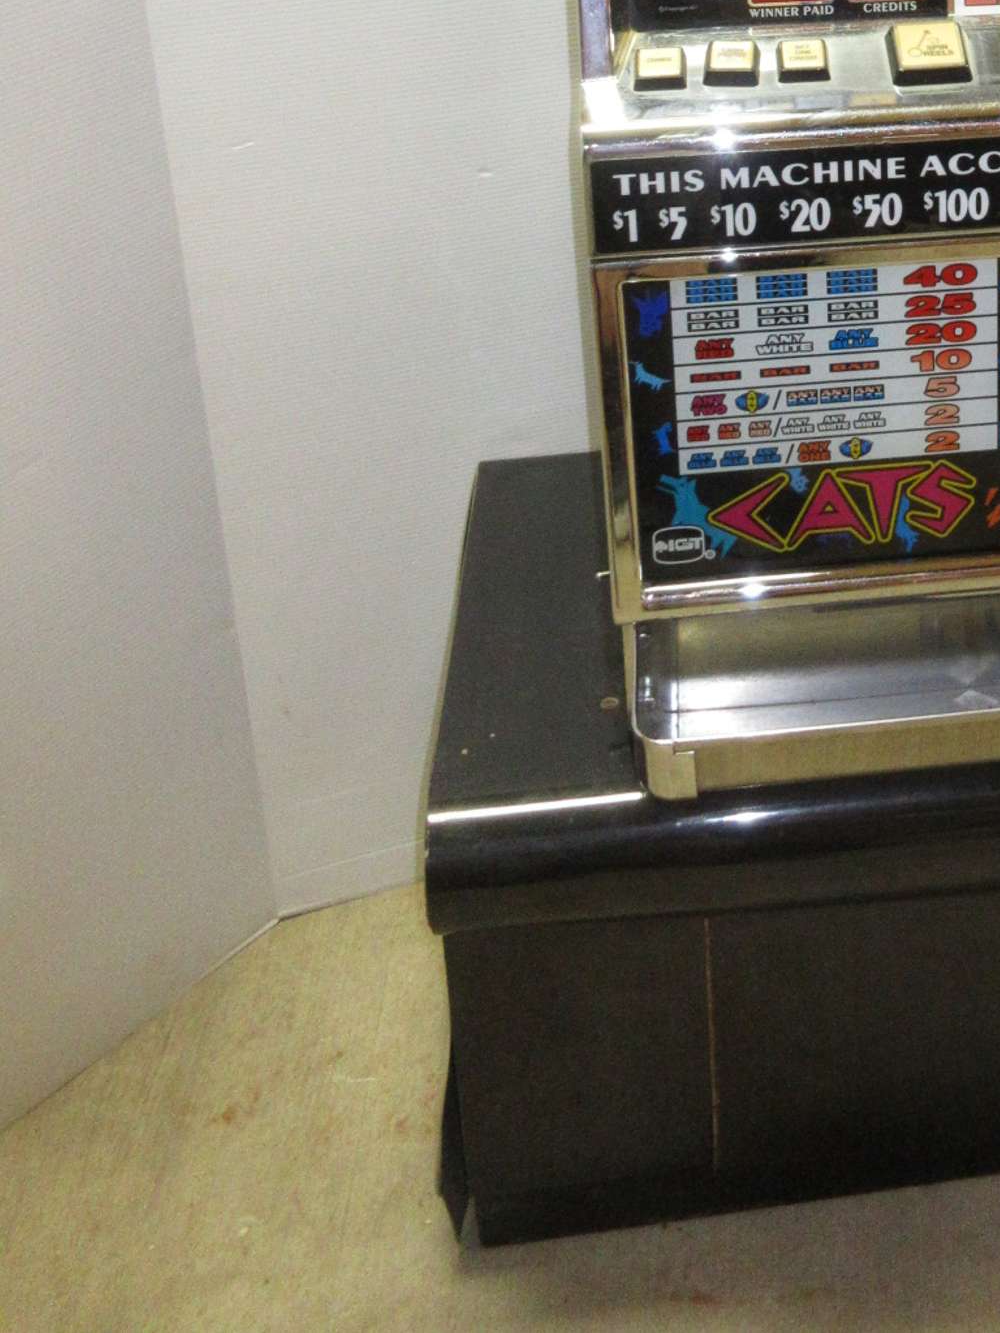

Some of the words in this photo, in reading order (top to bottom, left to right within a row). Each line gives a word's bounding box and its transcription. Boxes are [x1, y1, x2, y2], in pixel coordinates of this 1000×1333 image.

[749, 6, 799, 19] WINNER
[803, 5, 834, 17] PAID
[863, 1, 917, 14] CREDITS
[612, 170, 705, 196] THIS
[720, 156, 907, 190] MACHINE
[612, 209, 638, 242] $1
[659, 206, 688, 240] $5
[710, 202, 757, 237] $10
[779, 197, 831, 232] $20
[852, 192, 903, 228] $50
[923, 187, 990, 223] $100
[903, 263, 978, 287] 40
[904, 293, 976, 318] 25
[766, 333, 805, 345] ANY
[905, 320, 977, 345] 20
[756, 342, 814, 355] WHITE
[911, 348, 973, 372] 10
[923, 376, 960, 398] 5
[924, 404, 960, 426] 2
[924, 431, 960, 453] 2
[708, 460, 977, 553] CATS
